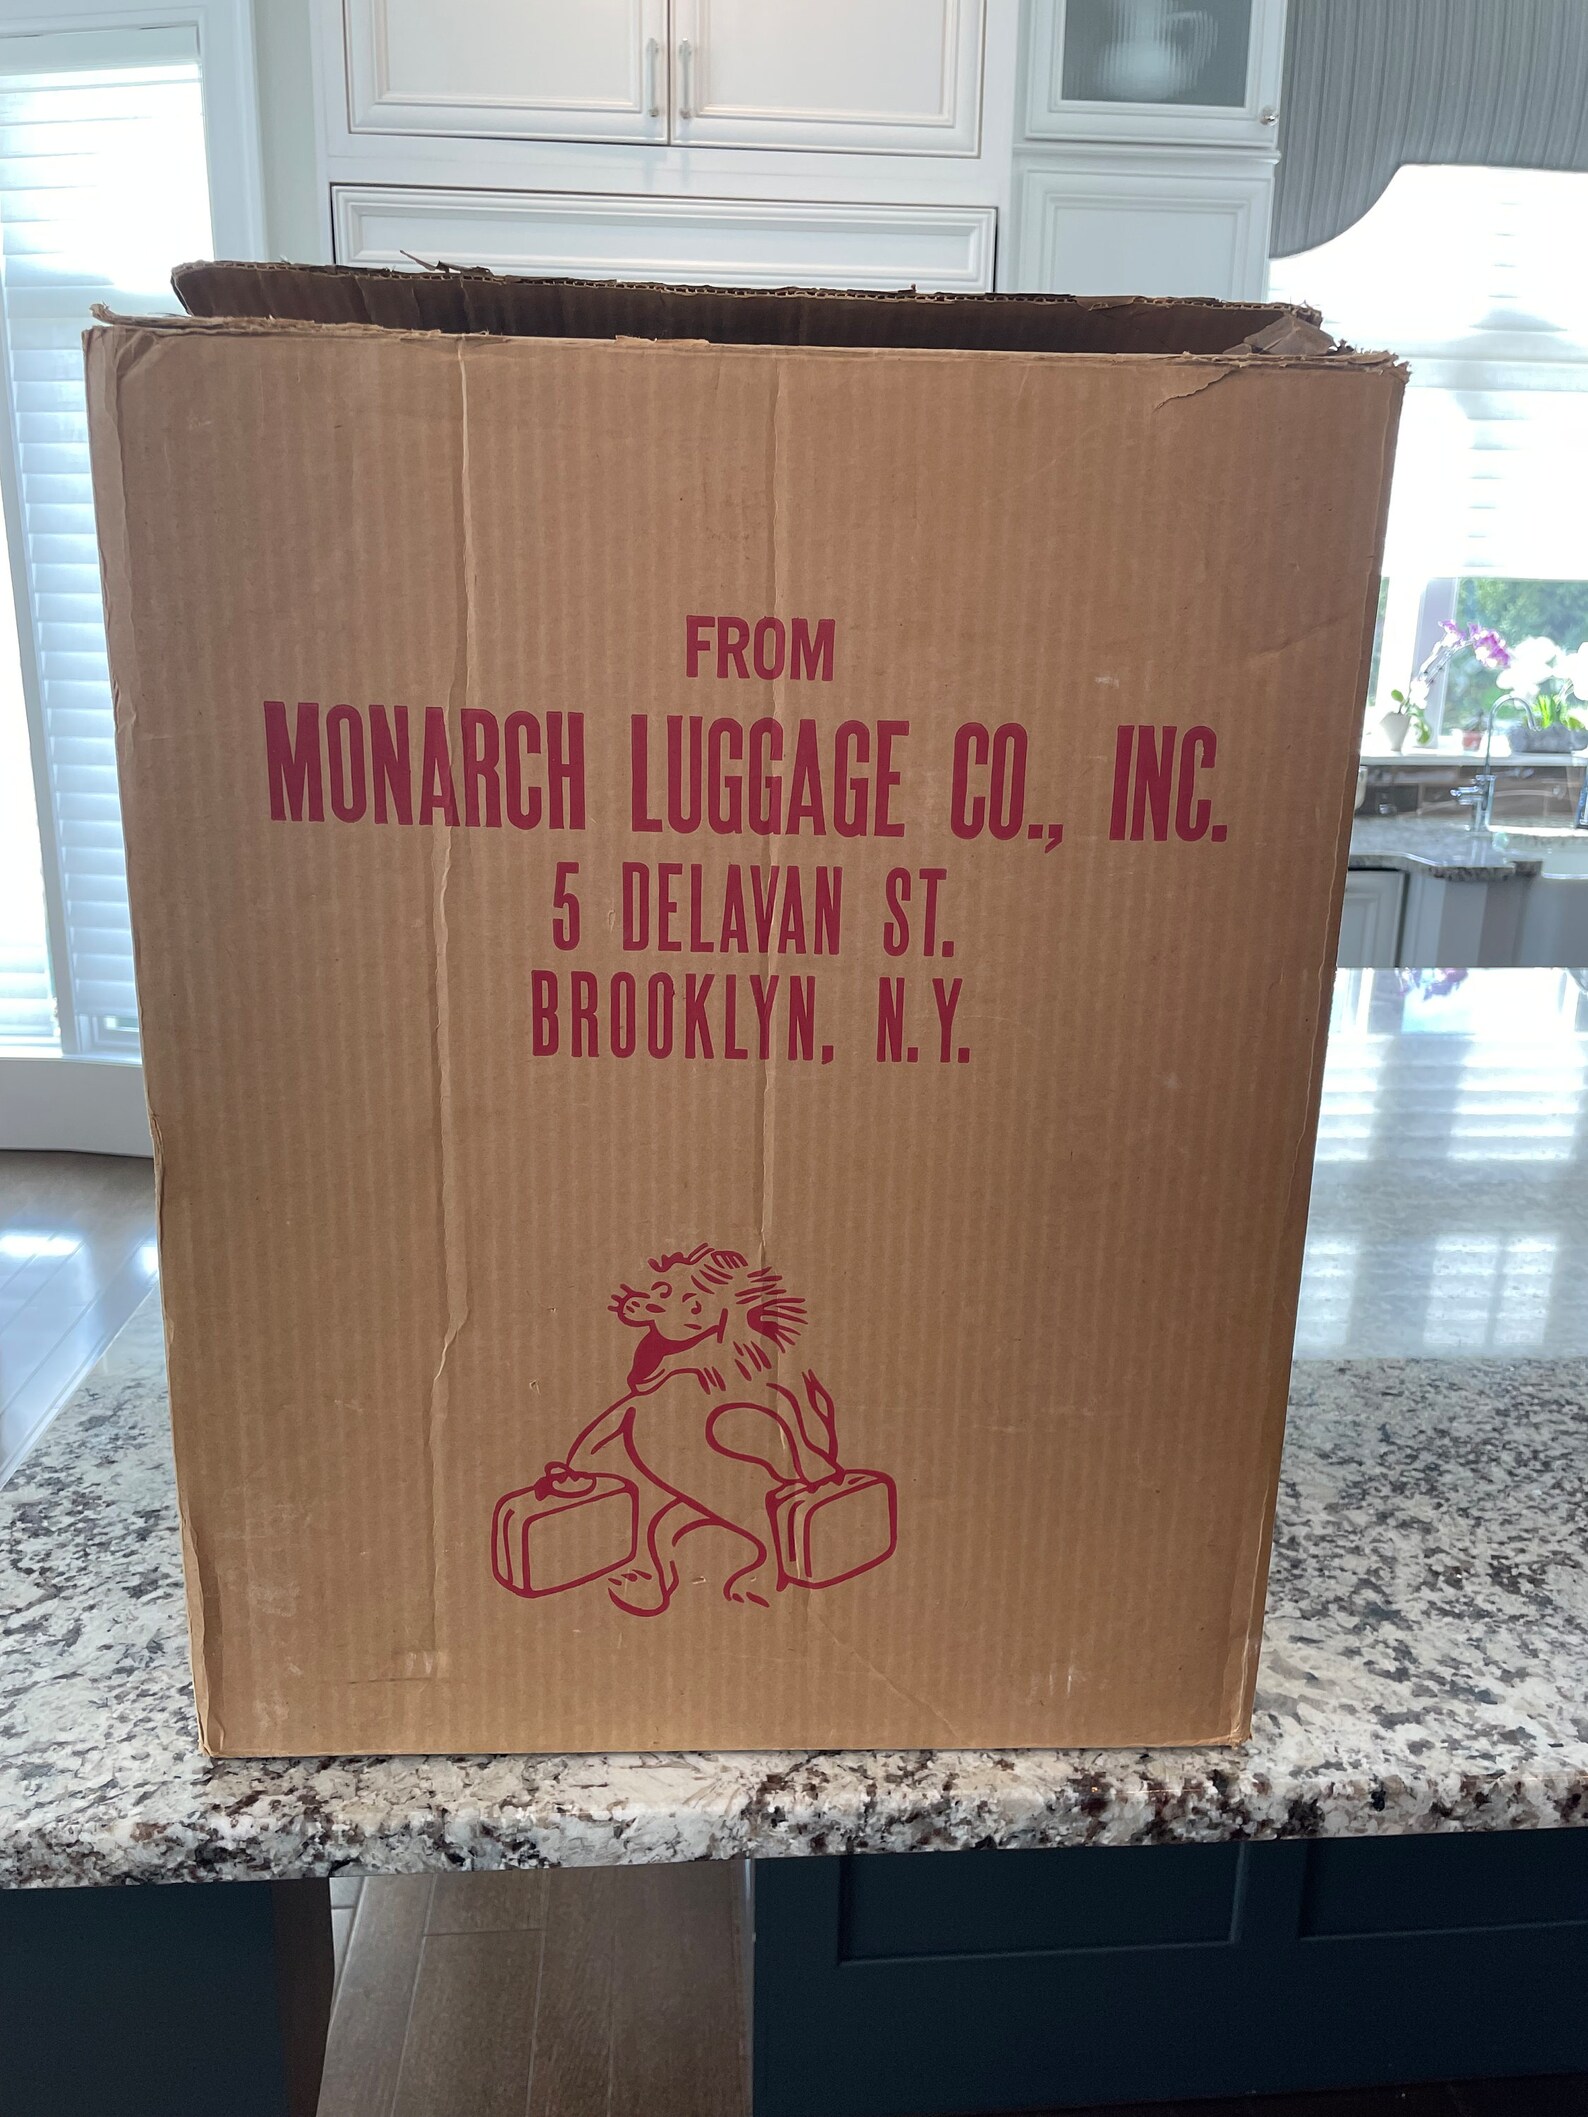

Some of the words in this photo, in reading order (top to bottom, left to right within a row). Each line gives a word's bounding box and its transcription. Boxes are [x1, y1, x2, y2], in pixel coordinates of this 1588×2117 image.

[685, 615, 836, 682] FROM
[263, 701, 586, 830] MONARCH
[630, 713, 910, 838] LUGGAGE
[951, 722, 1064, 853] CO.,
[1108, 723, 1229, 843] INC.
[552, 861, 581, 951] 5
[622, 861, 843, 956] DELAVAN
[883, 867, 955, 958] ST.
[531, 969, 834, 1064] BROOKLYN,
[876, 976, 971, 1063] N.Y.
